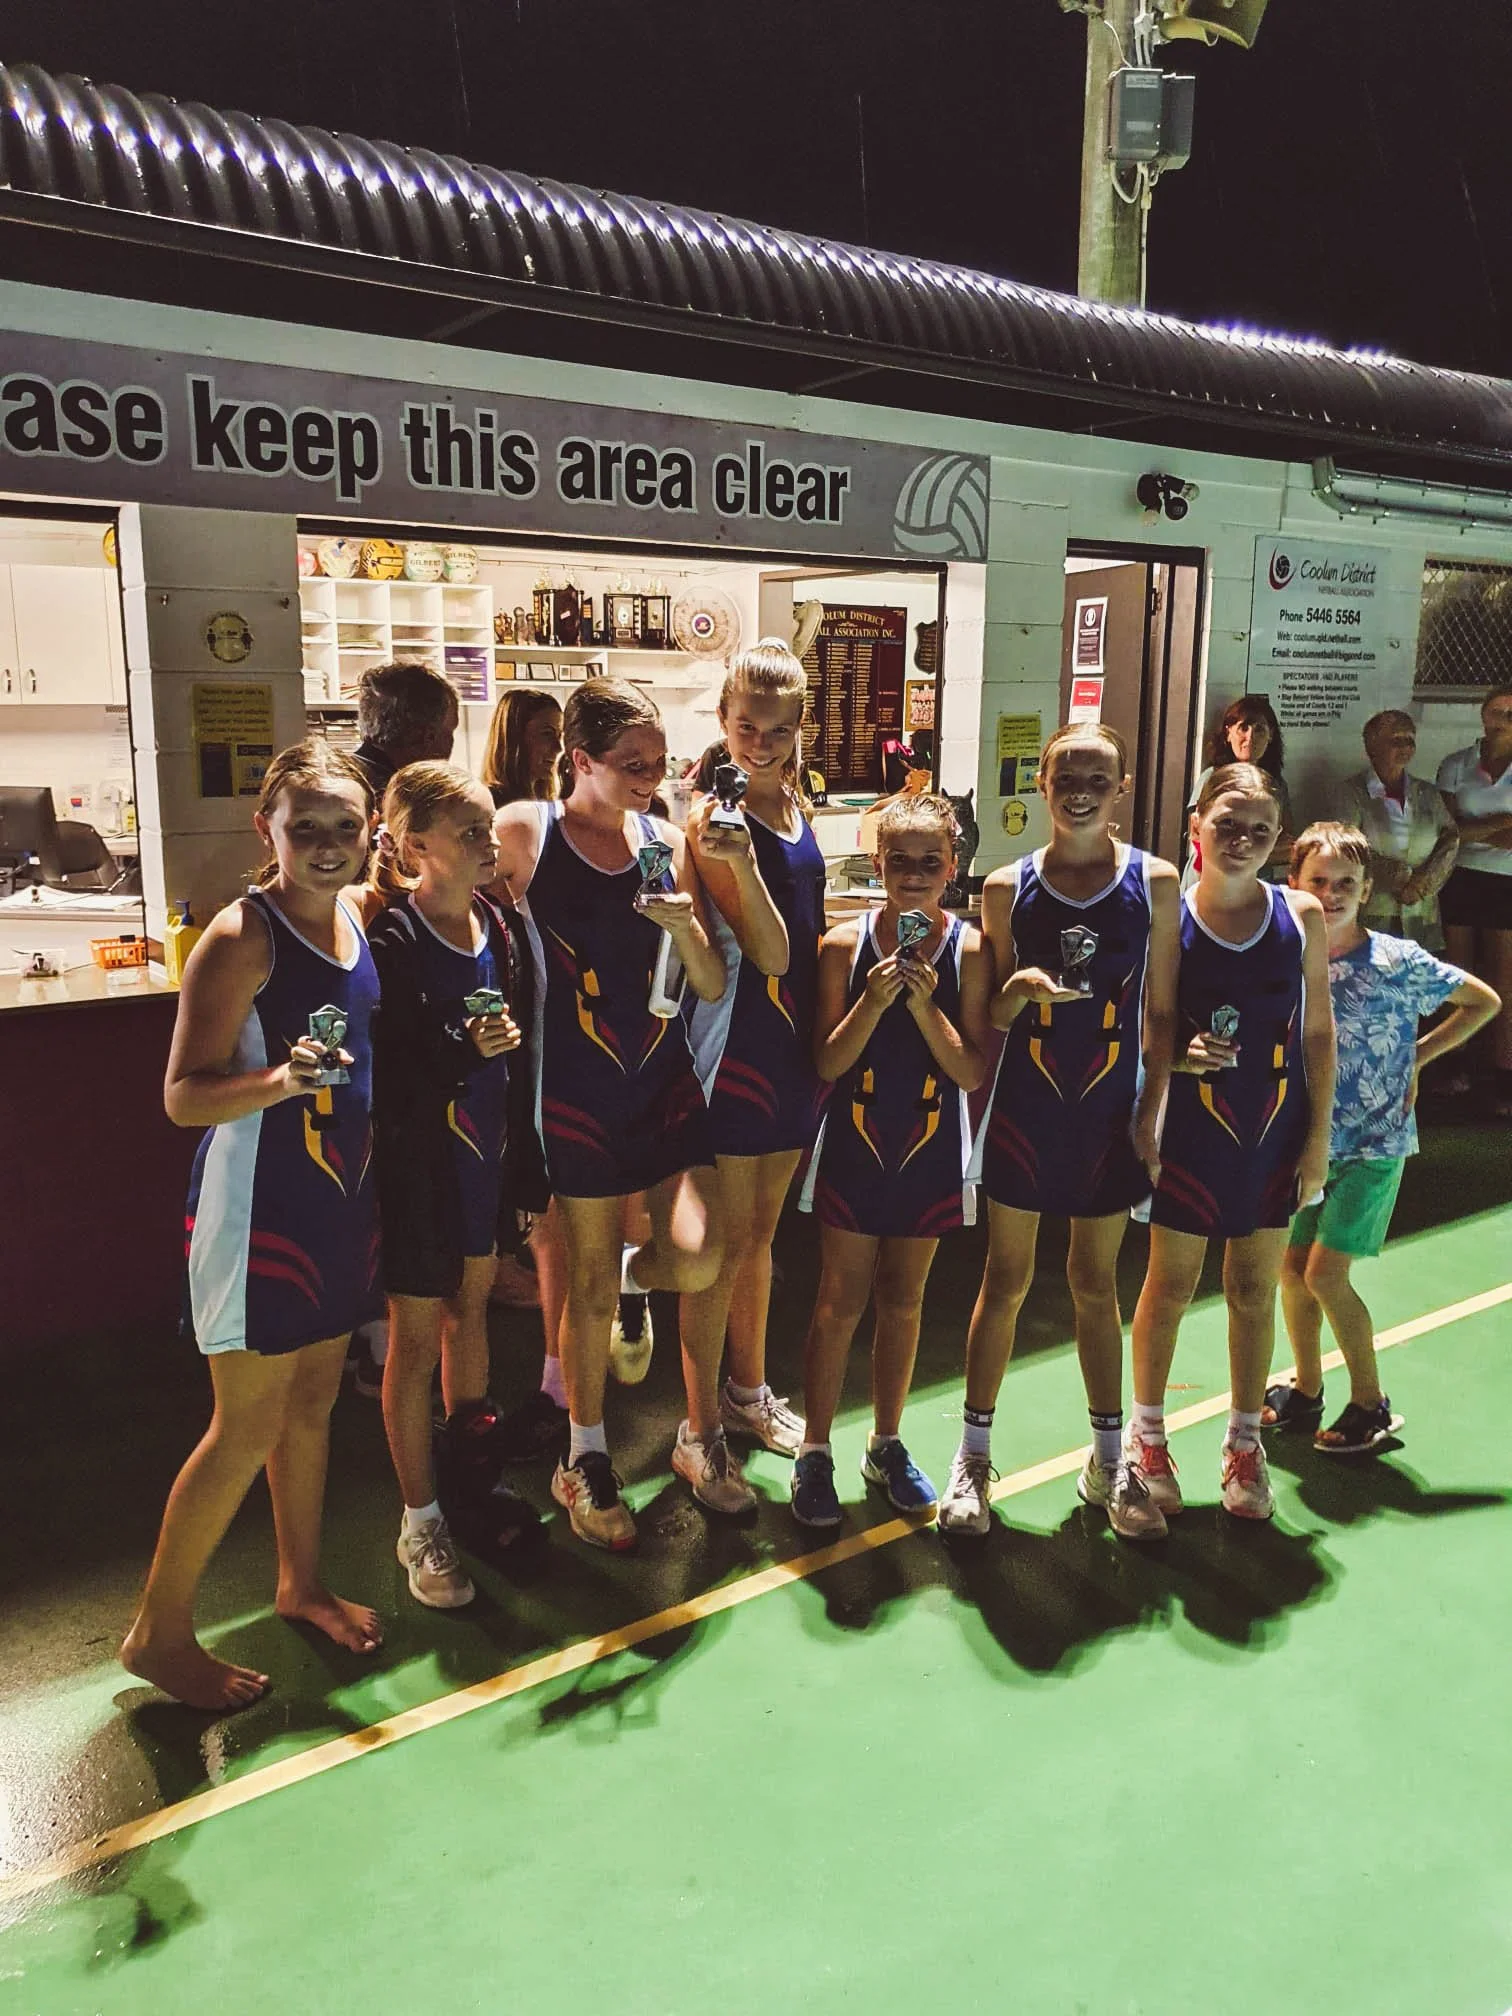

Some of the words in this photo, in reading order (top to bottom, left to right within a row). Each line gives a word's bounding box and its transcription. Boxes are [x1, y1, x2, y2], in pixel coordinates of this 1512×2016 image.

[186, 373, 384, 503] keep
[403, 401, 540, 500] this
[556, 435, 698, 515] area
[712, 438, 851, 526] clear
[1300, 557, 1338, 580] Coolum
[1341, 562, 1377, 584] District
[824, 611, 846, 620] OLUM
[850, 610, 885, 626] DISTRICT
[1279, 609, 1304, 622] Phone
[1306, 607, 1333, 623] 5446
[1335, 609, 1361, 625] 5564
[833, 628, 879, 637] ASSOCIATION
[1272, 647, 1291, 658] Email:
